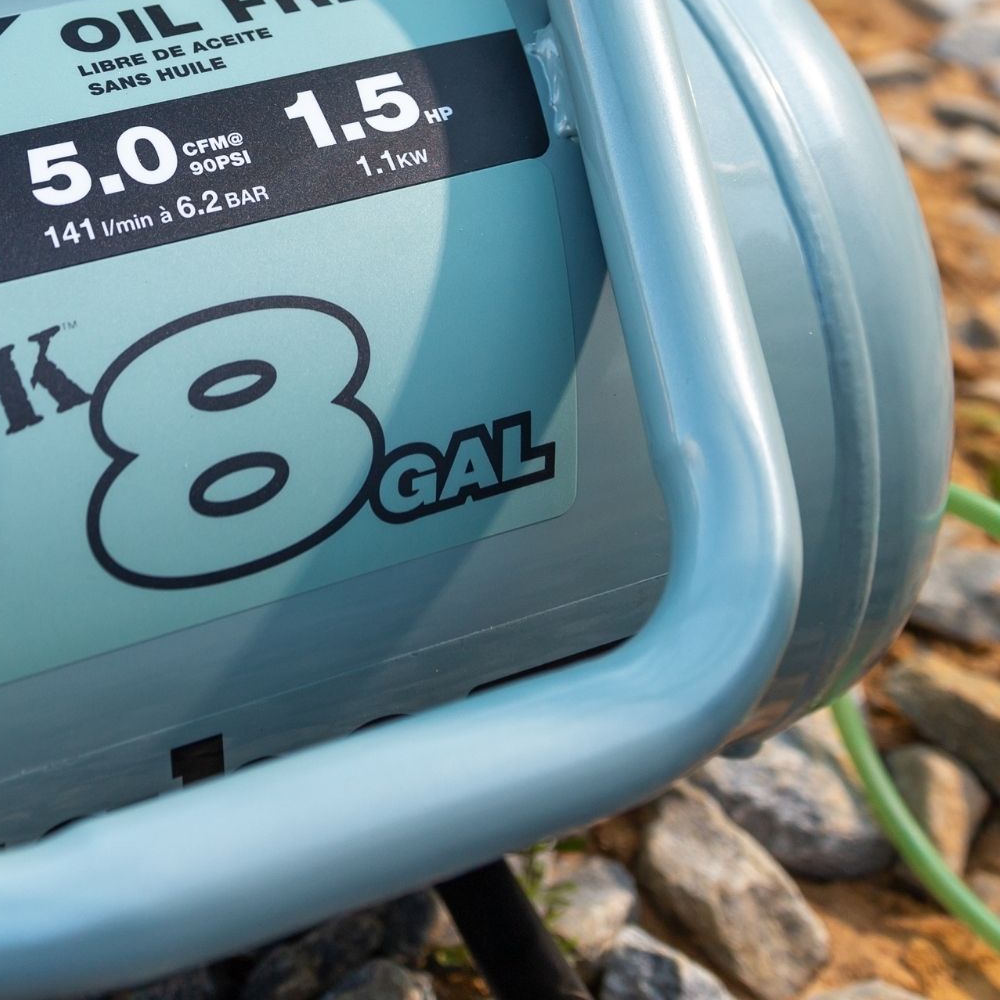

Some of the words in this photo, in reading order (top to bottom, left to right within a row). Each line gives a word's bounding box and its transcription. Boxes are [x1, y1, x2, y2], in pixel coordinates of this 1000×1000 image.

[60, 4, 203, 53] OIL
[77, 52, 147, 77] LIBRE
[152, 45, 186, 62] DE
[193, 27, 273, 54] ACEITE
[88, 72, 152, 96] SANS
[156, 56, 227, 82] HUILE
[284, 72, 420, 149] 1.5
[424, 106, 454, 125] HP
[26, 125, 178, 206] 5.0
[182, 132, 244, 157] CFM@
[44, 217, 96, 249] 141
[159, 205, 173, 224] à
[176, 190, 222, 219] 6.2
[224, 185, 270, 209] BAR
[86, 295, 385, 590] 8
[370, 411, 555, 524] GAL
